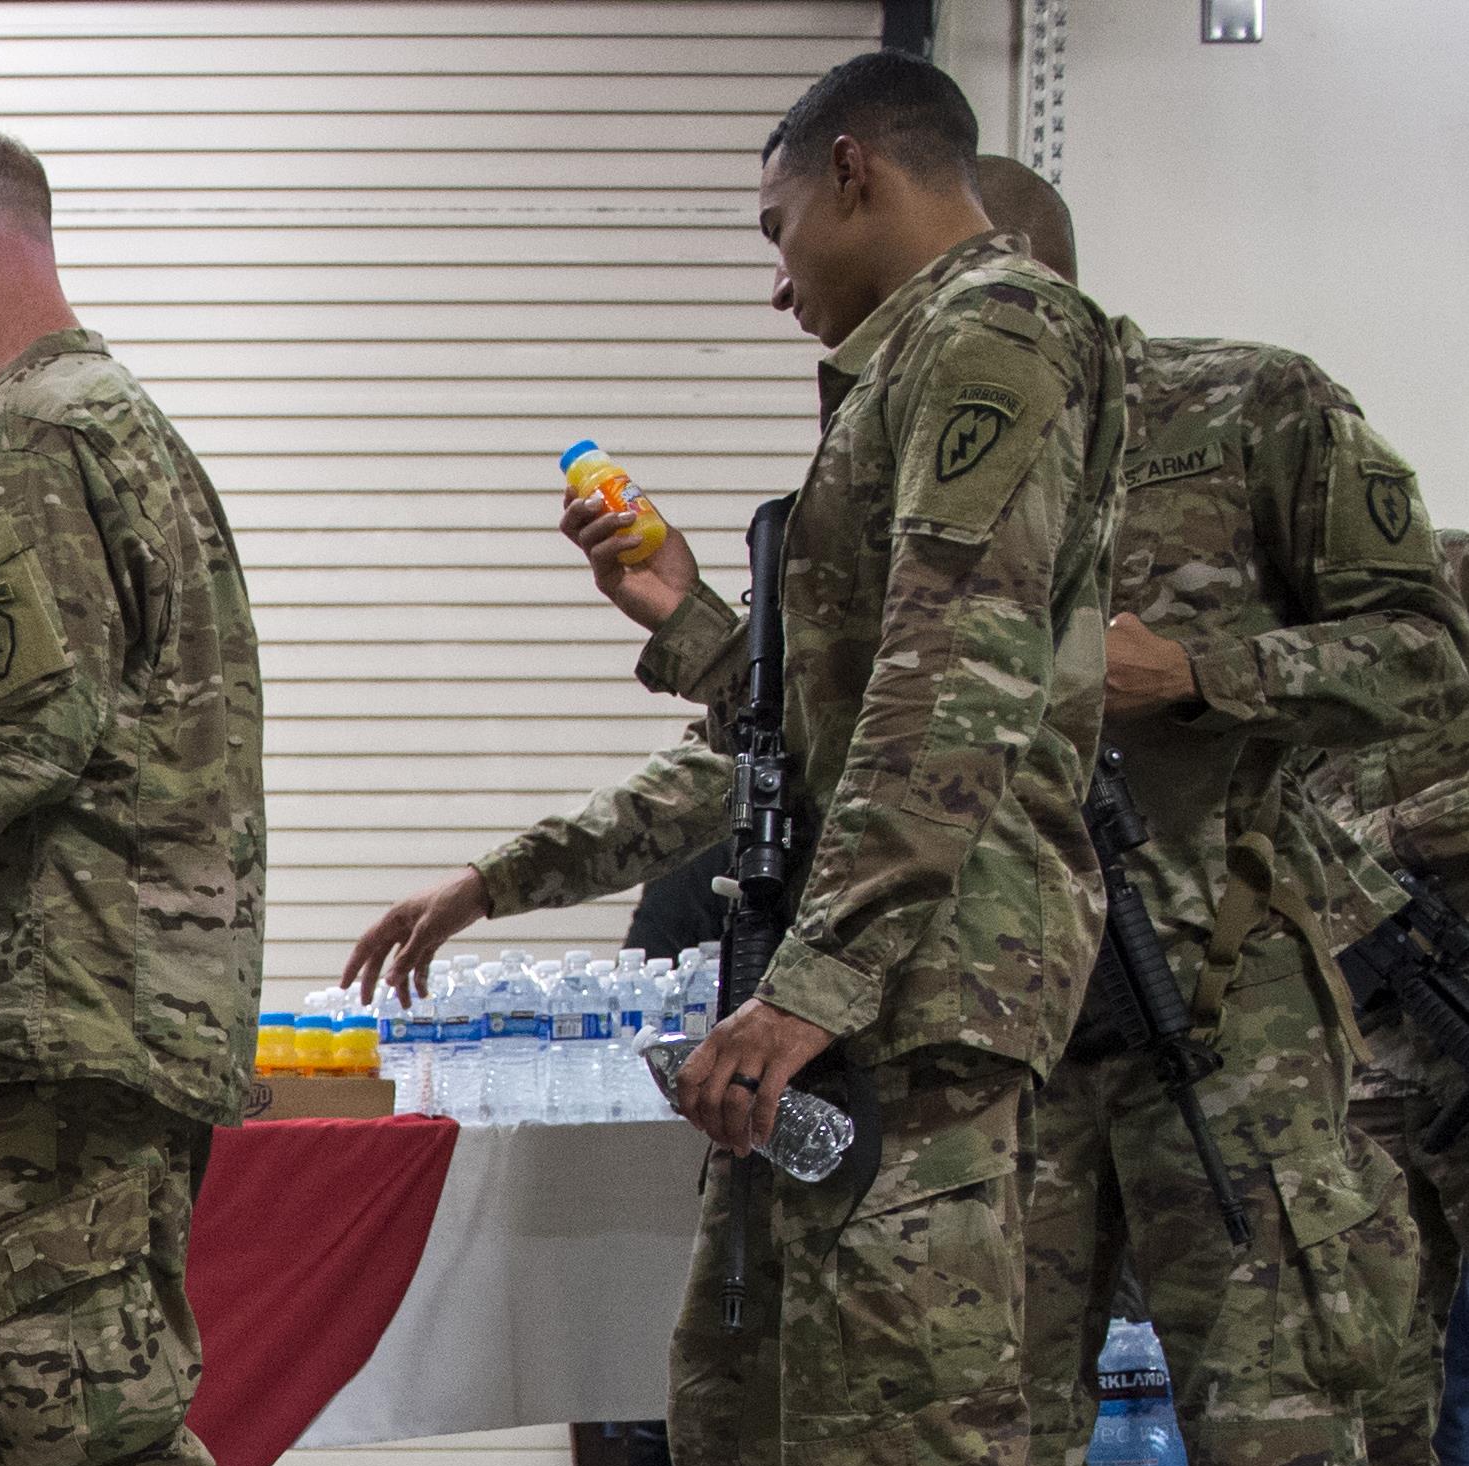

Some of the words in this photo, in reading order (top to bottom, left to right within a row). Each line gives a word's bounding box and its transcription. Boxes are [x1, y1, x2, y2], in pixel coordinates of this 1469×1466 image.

[957, 387, 1021, 412] AIRBORNE
[1148, 447, 1208, 478] ARMY
[1098, 1372, 1165, 1389] RKLAND
